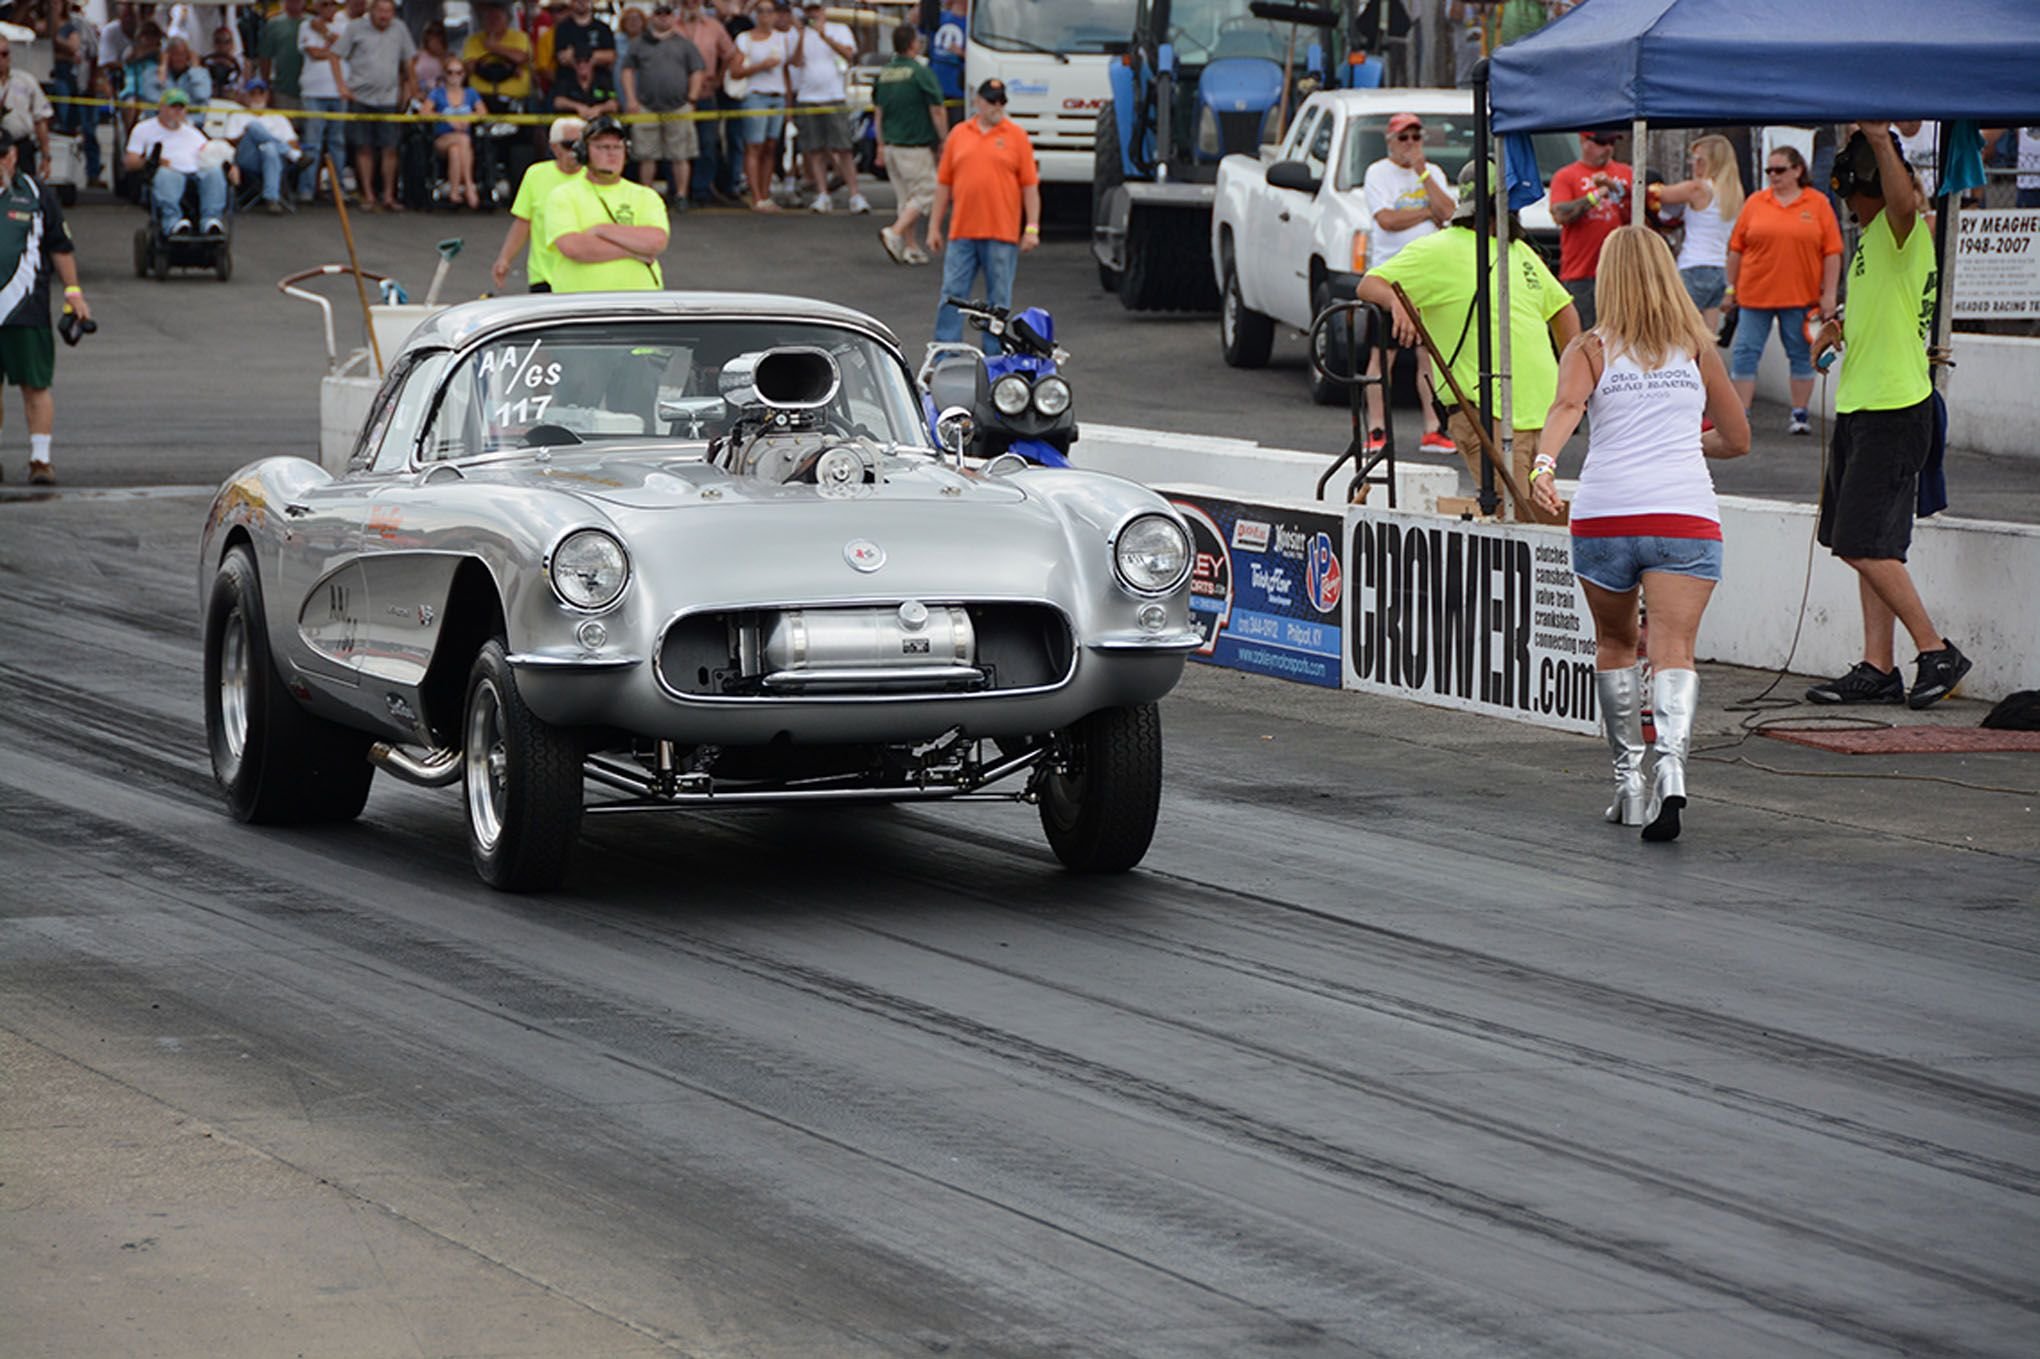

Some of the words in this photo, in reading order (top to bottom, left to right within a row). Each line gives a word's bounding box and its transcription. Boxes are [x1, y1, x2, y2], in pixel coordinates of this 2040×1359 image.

[1980, 216, 2040, 233] MEAGHE
[1959, 237, 2030, 254] 1948-2007
[1611, 373, 1639, 383] OLD
[496, 395, 553, 428] 117
[1536, 545, 1568, 565] clutches
[1536, 568, 1575, 588] camshafts
[1536, 588, 1554, 606] valve
[1557, 591, 1574, 609] train
[1352, 520, 1532, 712] CROWER
[1534, 656, 1595, 722] .com
[1535, 611, 1580, 632] crankshafts
[1535, 632, 1576, 655] connecting
[1578, 638, 1596, 656] rods
